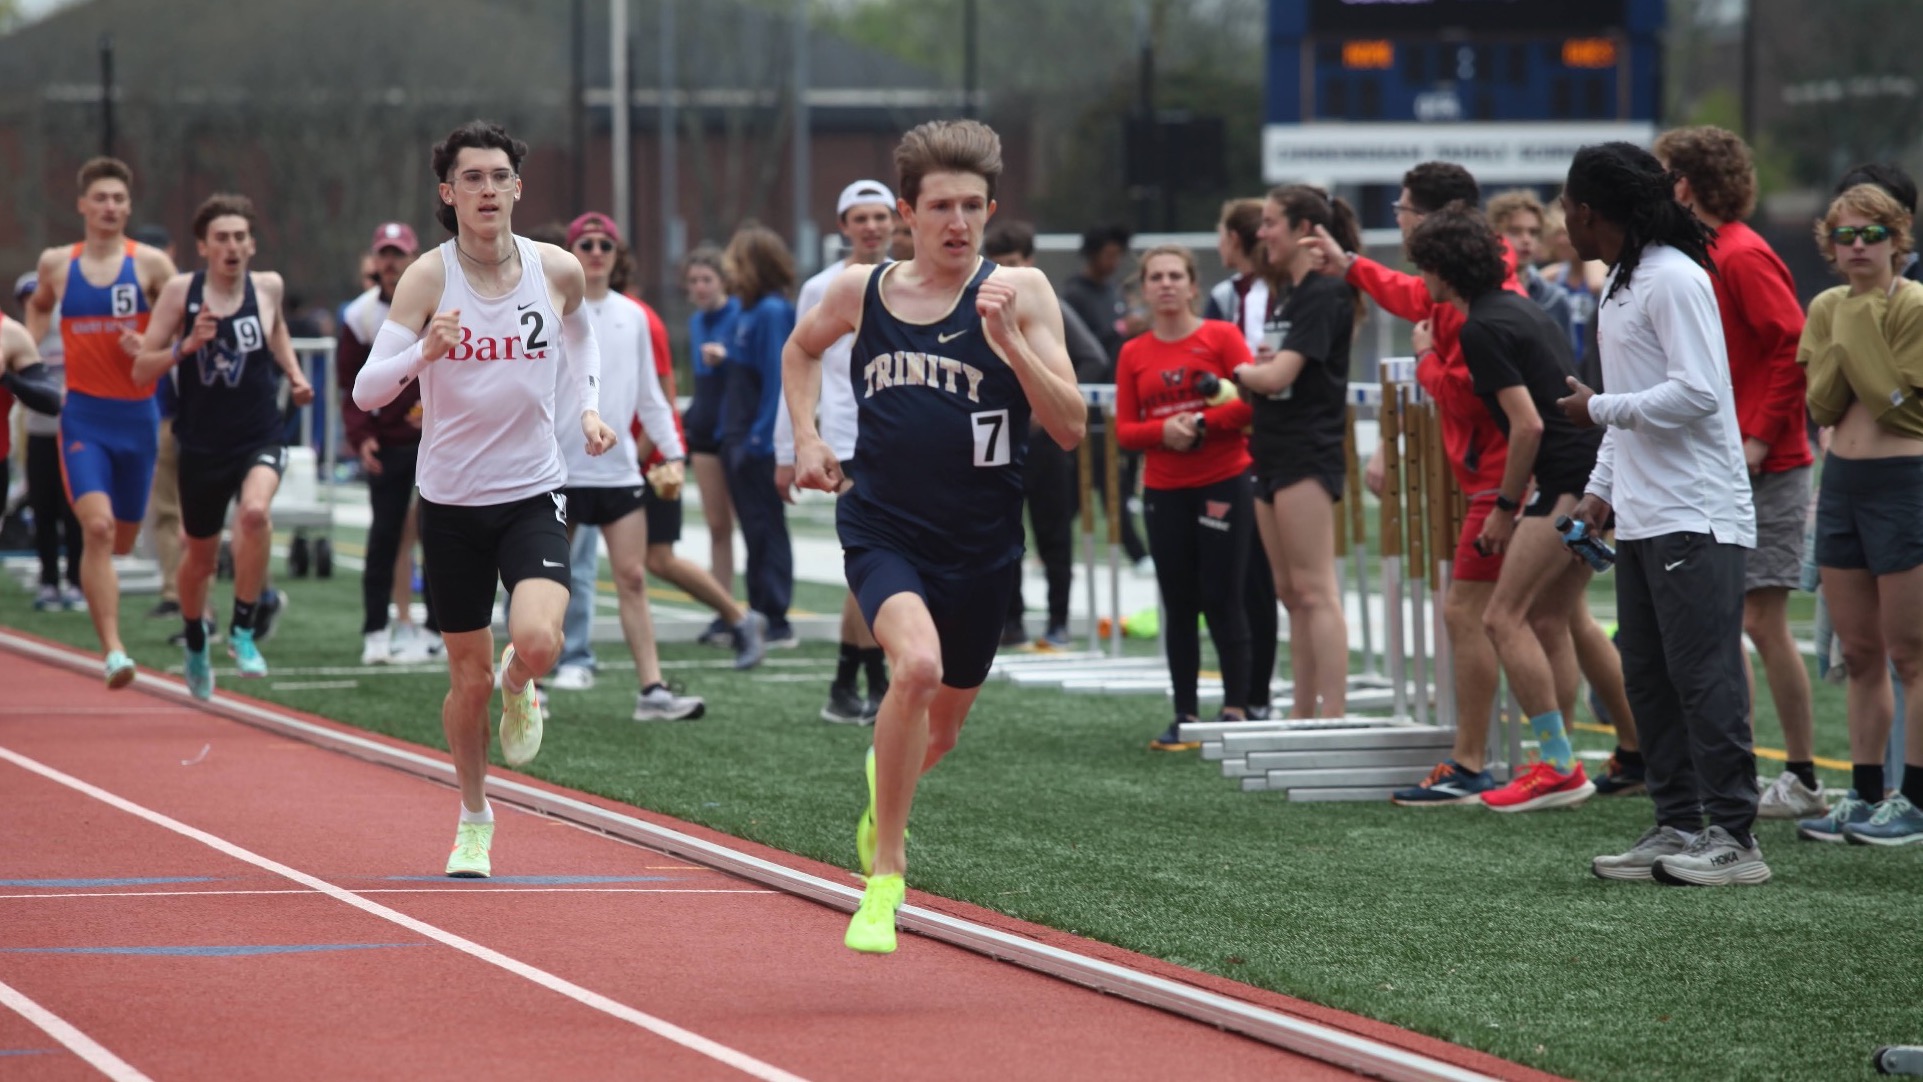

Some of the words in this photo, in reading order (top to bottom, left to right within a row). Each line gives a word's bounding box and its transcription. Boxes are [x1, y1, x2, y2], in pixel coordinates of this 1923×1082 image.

[116, 288, 132, 315] 5
[240, 320, 256, 347] 9
[520, 311, 548, 351] 2
[864, 350, 984, 403] TRINITY
[977, 414, 1003, 462] 7
[1710, 851, 1739, 867] HOKA
